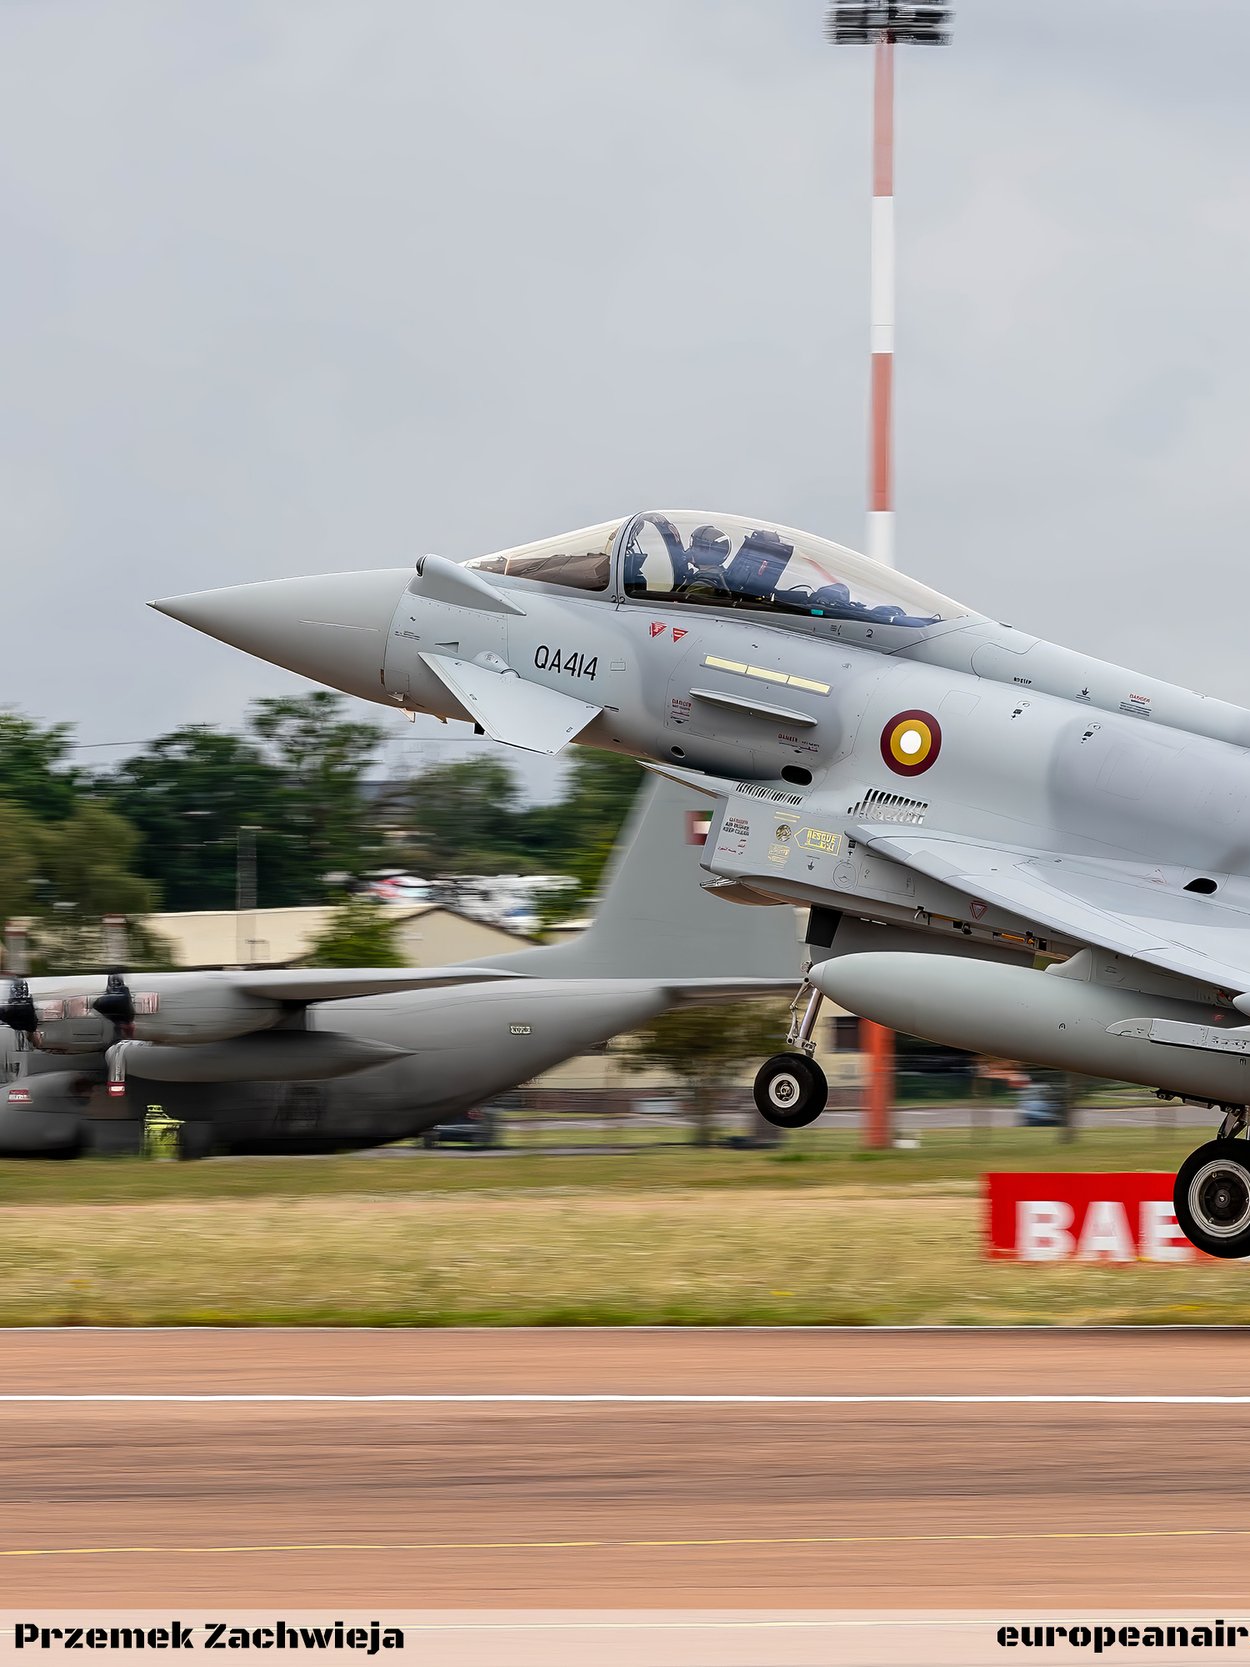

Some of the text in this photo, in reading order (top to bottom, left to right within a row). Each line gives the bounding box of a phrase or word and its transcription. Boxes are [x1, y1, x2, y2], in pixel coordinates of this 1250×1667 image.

[866, 628, 873, 638] 2
[535, 645, 598, 681] QA414
[1015, 1200, 1197, 1262] BAE
